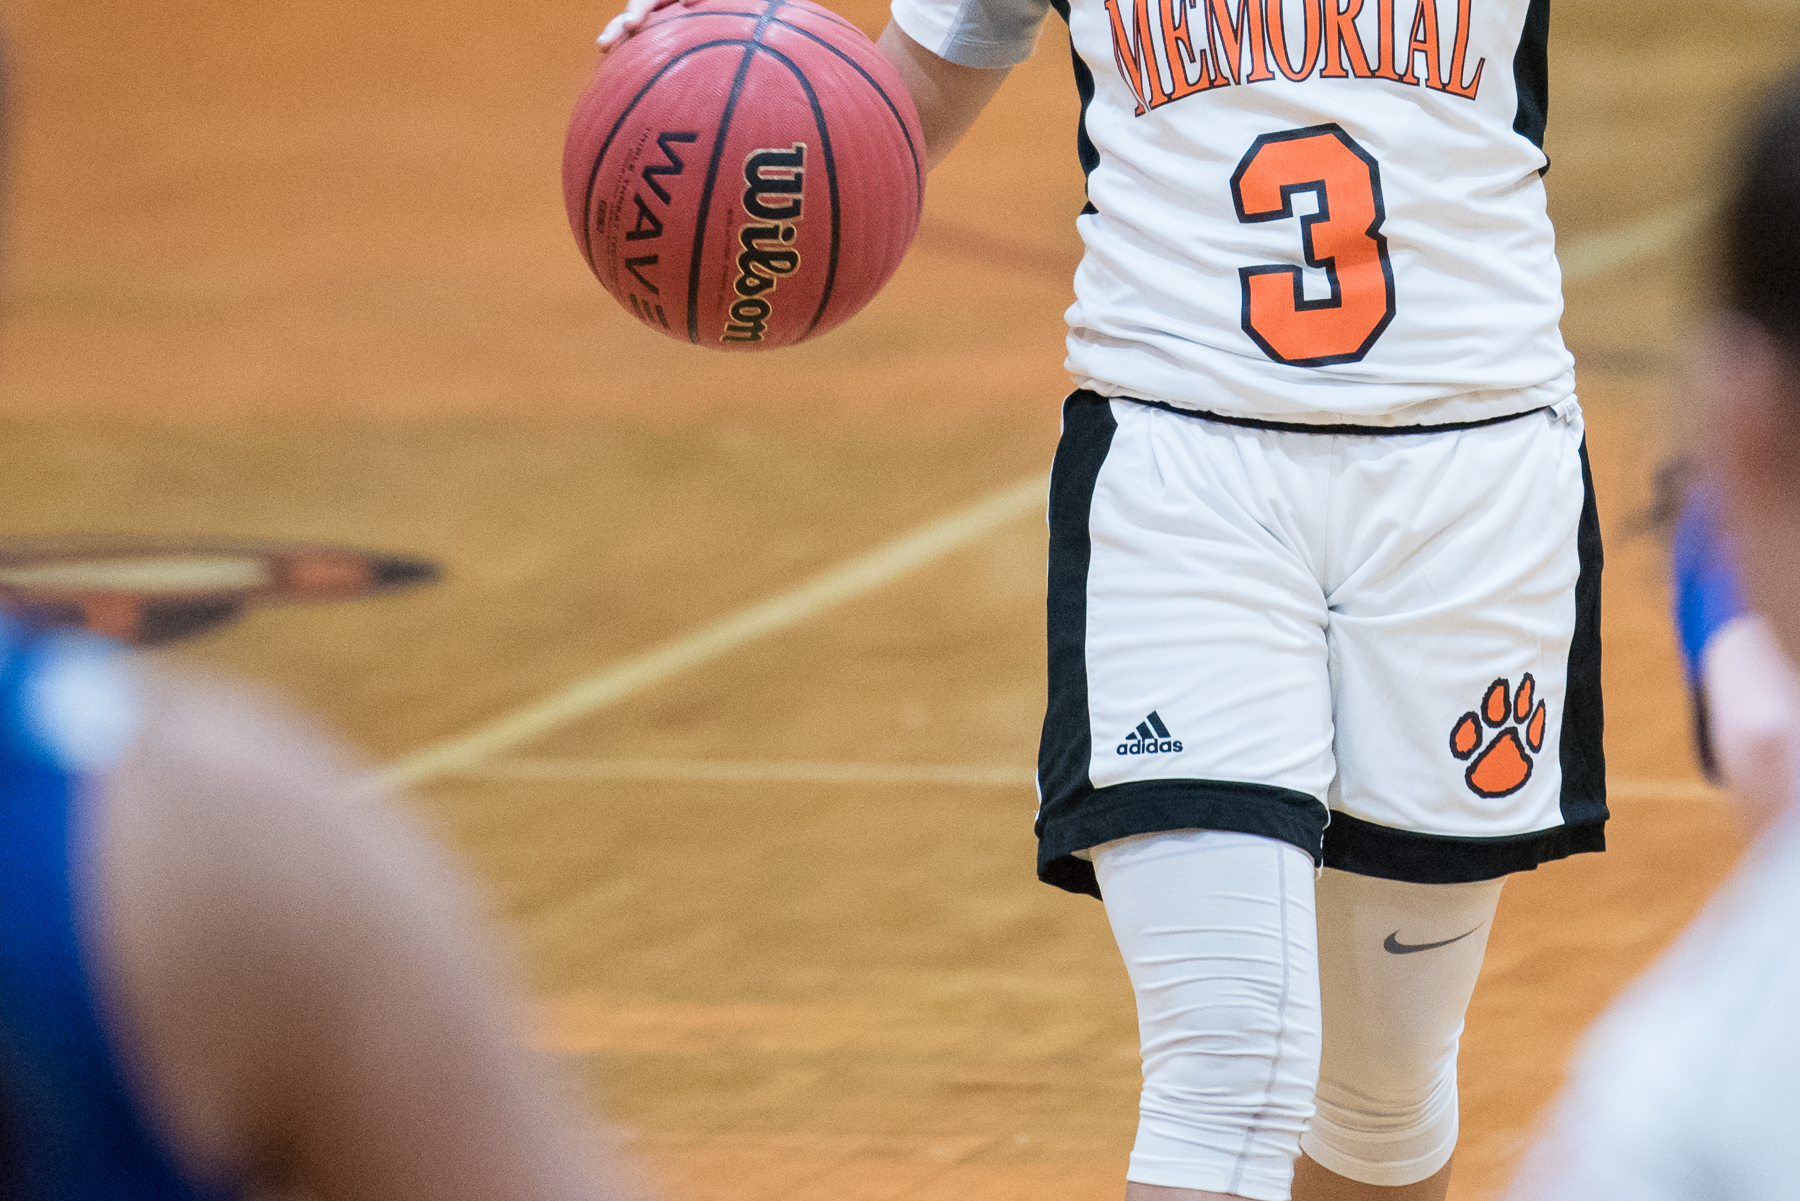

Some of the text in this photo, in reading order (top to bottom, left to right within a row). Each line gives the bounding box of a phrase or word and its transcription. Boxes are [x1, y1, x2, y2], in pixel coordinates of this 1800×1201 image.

[624, 131, 699, 330] WAVE
[719, 141, 807, 345] Wilson
[1229, 122, 1397, 368] 3
[1116, 737, 1184, 756] adidas
